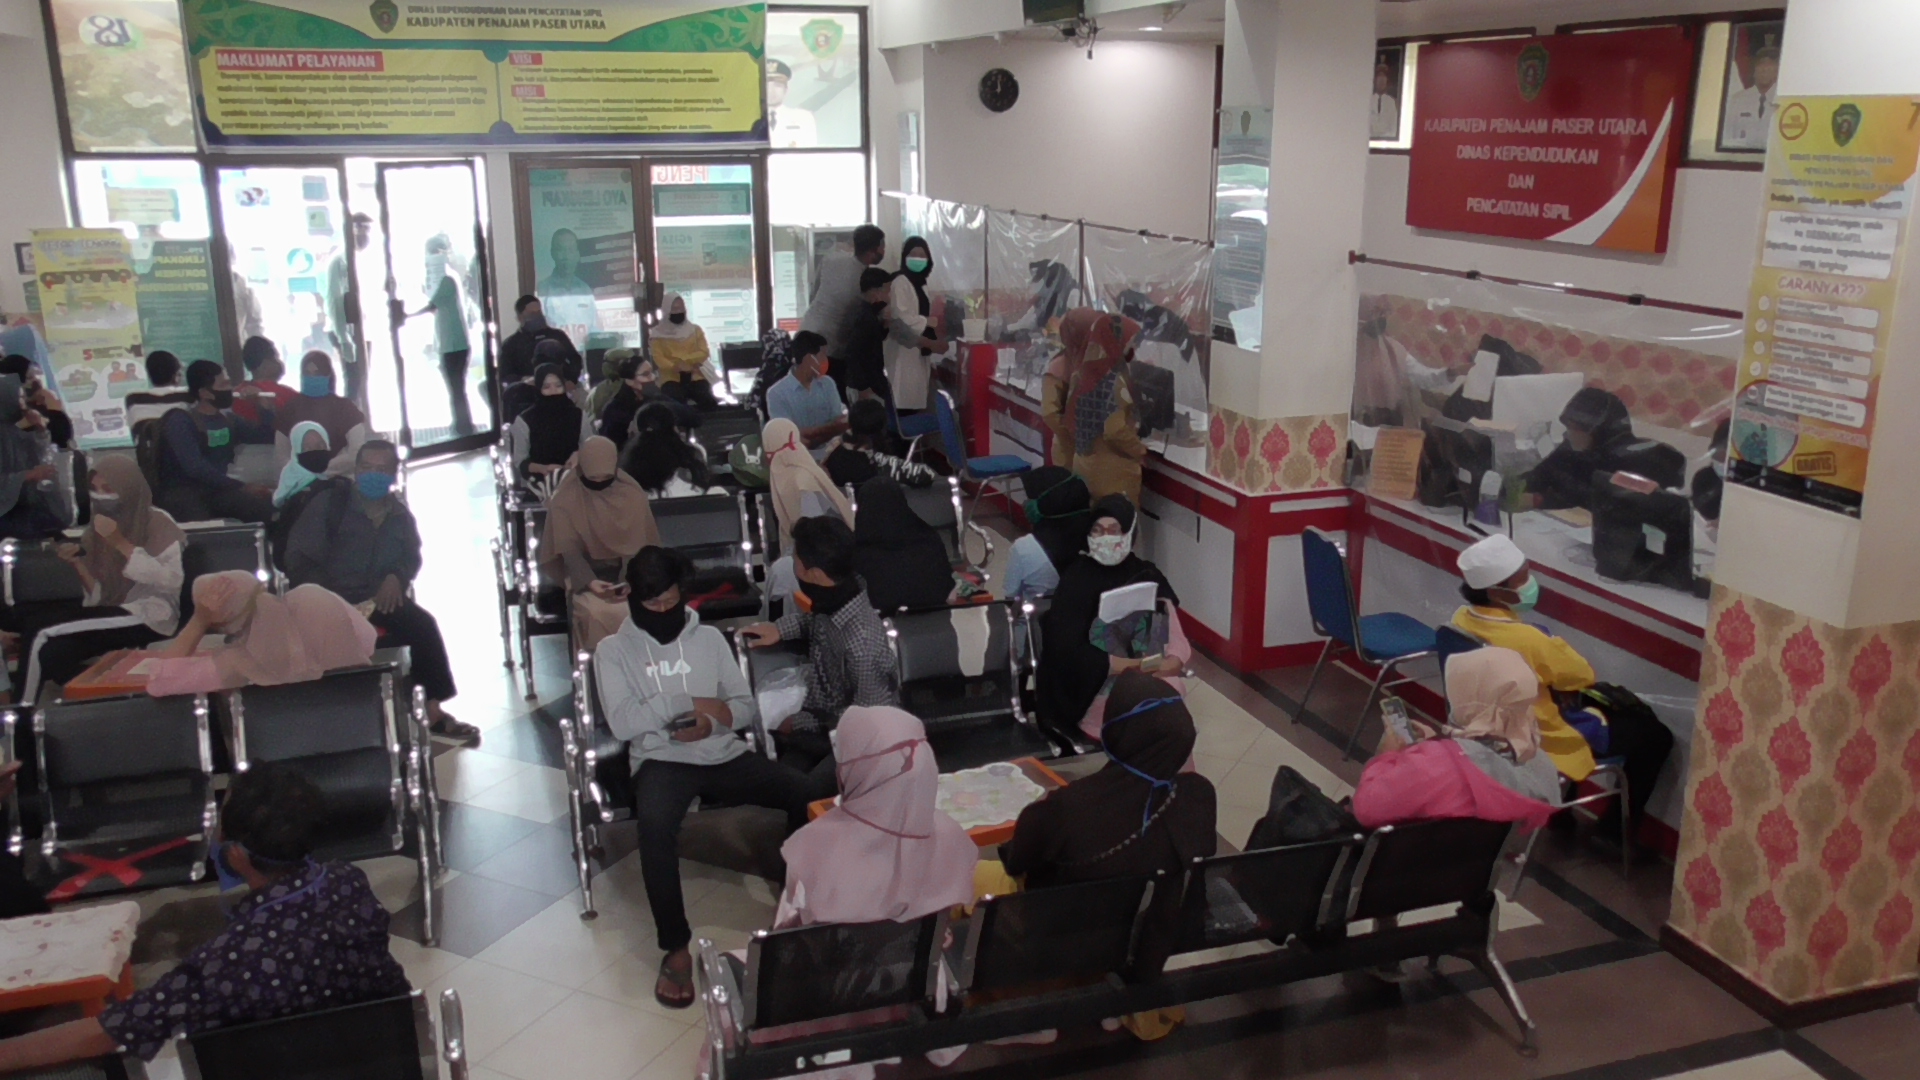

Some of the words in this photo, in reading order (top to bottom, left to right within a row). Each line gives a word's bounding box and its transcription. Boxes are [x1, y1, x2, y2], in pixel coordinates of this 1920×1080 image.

[407, 5, 435, 14] DINAS
[437, 6, 507, 15] KEPENDUDUKAN
[508, 7, 526, 15] DAN
[528, 7, 581, 17] PENCATATAN
[583, 8, 602, 18] SIPIL
[407, 16, 475, 28] KABUPATEN
[477, 17, 531, 29] PENAJAM
[532, 18, 568, 30] PASER
[570, 19, 607, 30] UTARA
[217, 53, 294, 67] MAKLUMAT
[298, 54, 376, 68] PELAYANAN
[512, 53, 533, 64] VISI
[1424, 118, 1487, 133] KABUPATEN
[1489, 118, 1548, 135] PENAJAM
[1551, 118, 1594, 135] PASER
[1598, 118, 1648, 136] UTARA
[1456, 145, 1491, 160] DINAS
[1494, 146, 1599, 165] KEPENDUDUKAN
[1508, 173, 1535, 190] DAN
[1466, 197, 1539, 217] PENCATATAN
[1542, 202, 1573, 221] SIPIL
